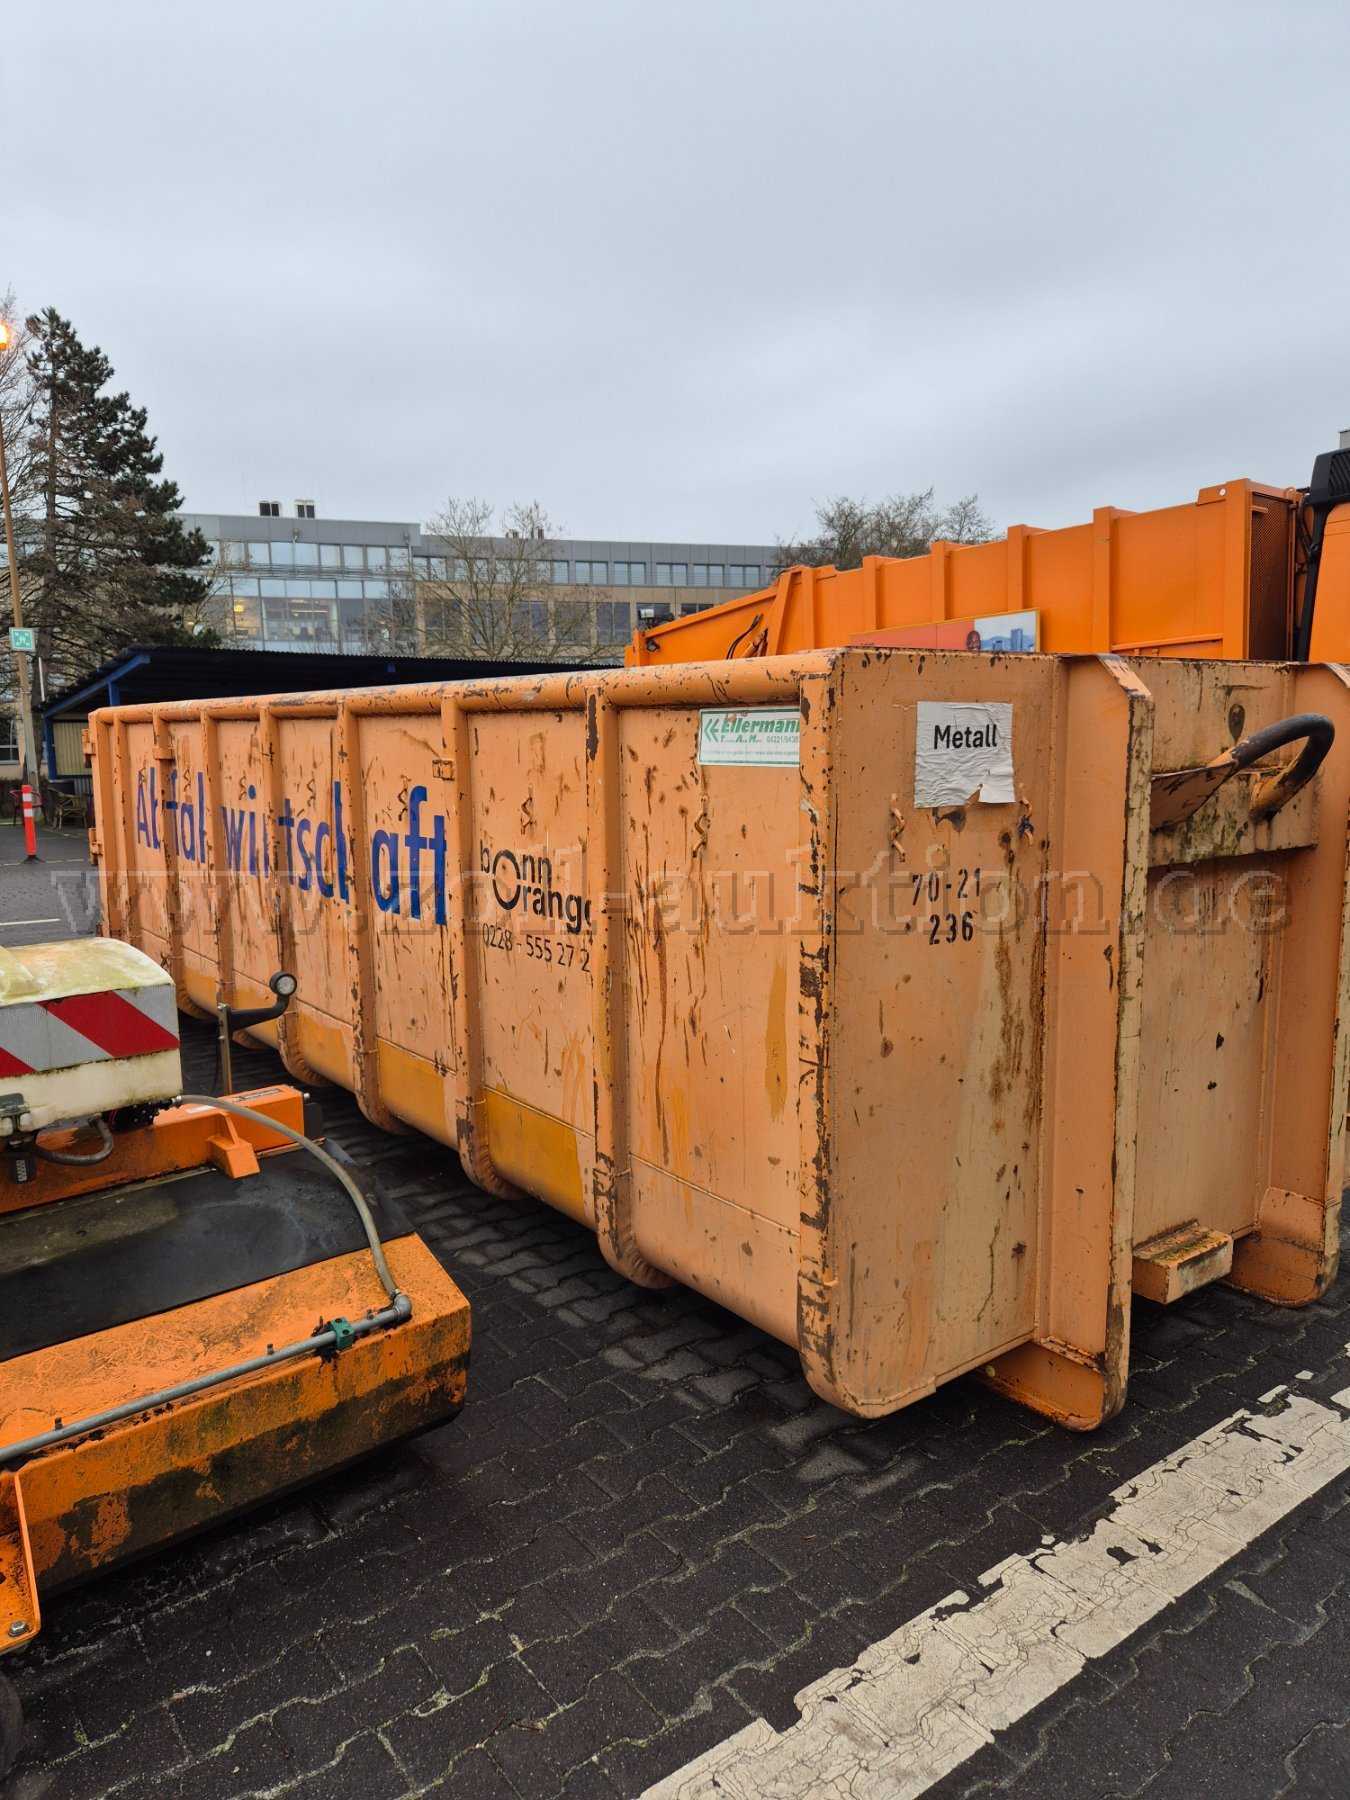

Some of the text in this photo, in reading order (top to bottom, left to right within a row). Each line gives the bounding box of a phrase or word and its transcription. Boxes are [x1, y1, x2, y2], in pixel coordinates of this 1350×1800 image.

[933, 724, 998, 750] Metall
[136, 766, 448, 926] Afalwitscaft
[482, 922, 513, 952] 0228
[526, 934, 553, 963] 555
[556, 942, 575, 968] 27
[928, 911, 974, 946] 236
